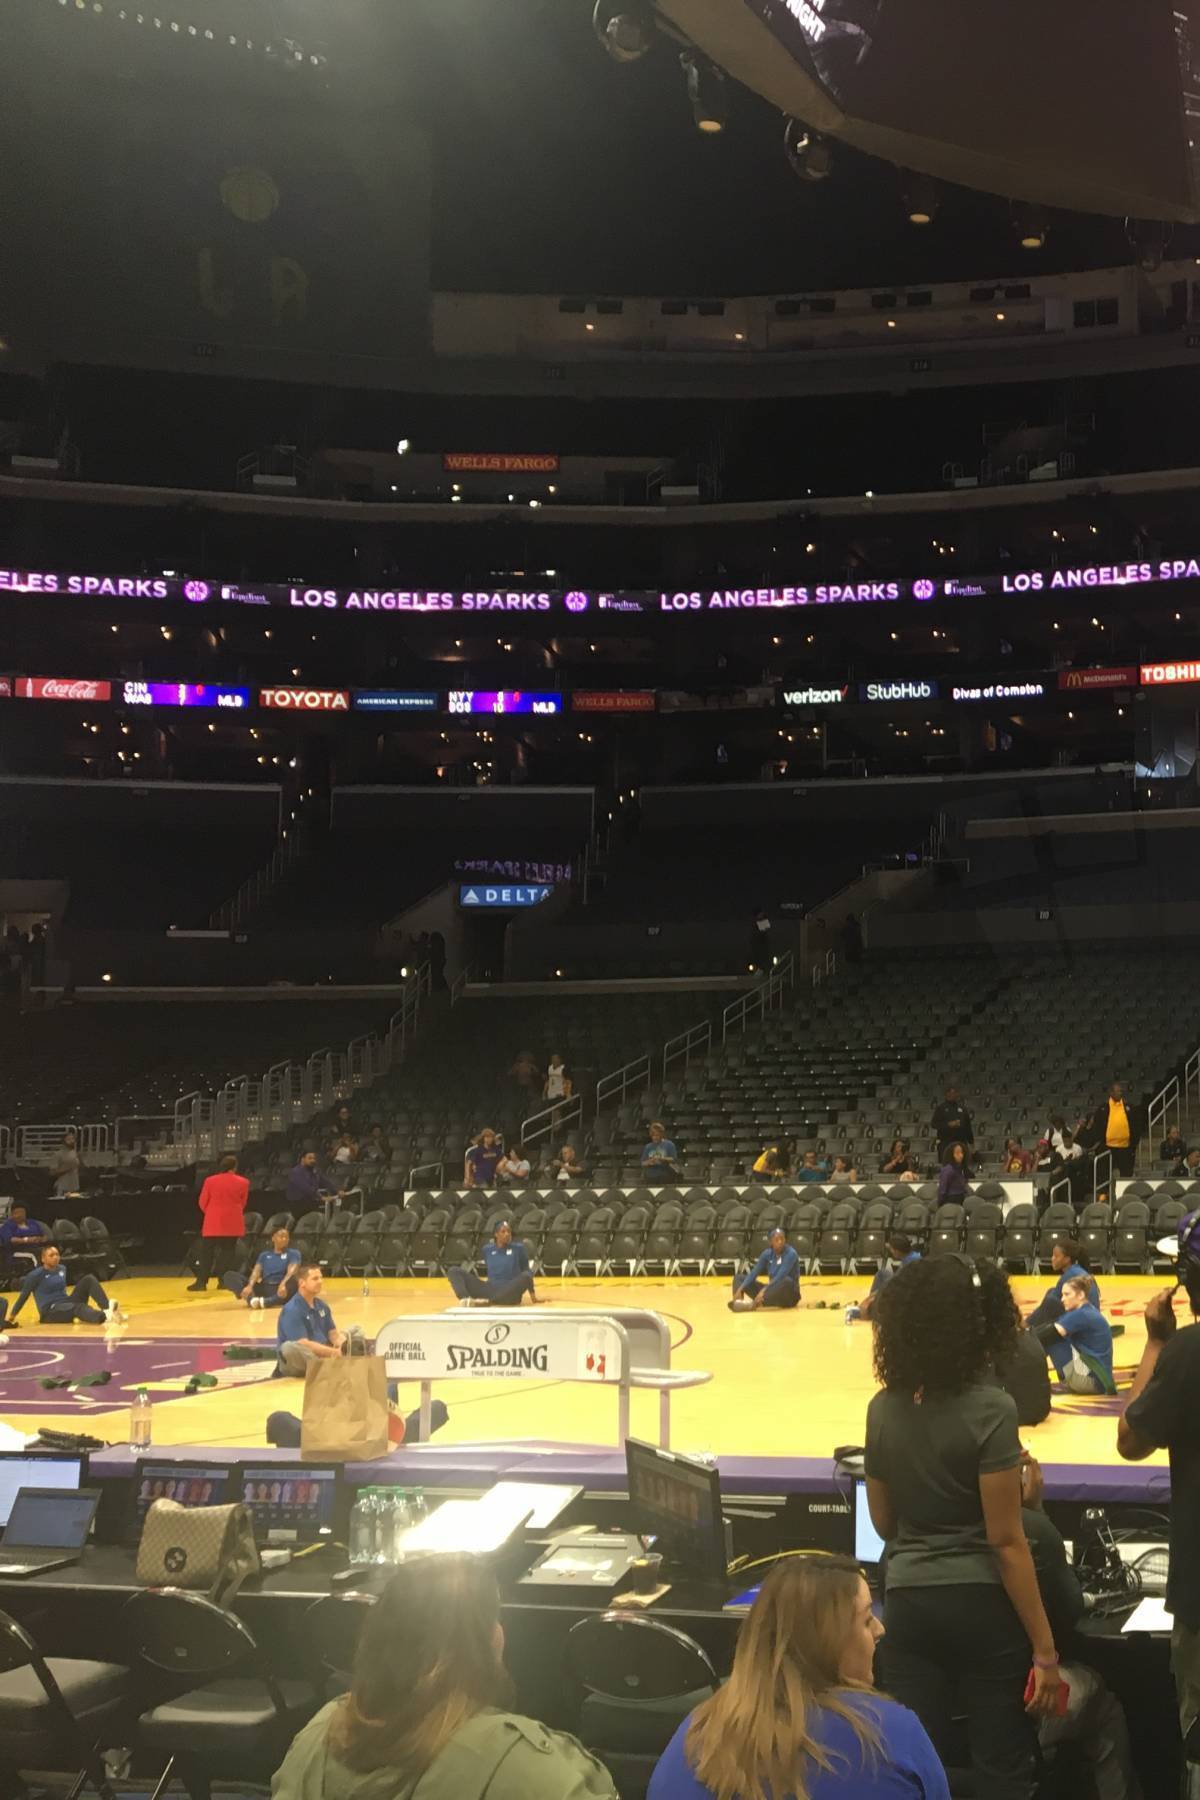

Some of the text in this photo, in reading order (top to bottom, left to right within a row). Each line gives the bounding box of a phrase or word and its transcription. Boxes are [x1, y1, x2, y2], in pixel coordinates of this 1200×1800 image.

[447, 457, 557, 470] WELLS FARGO
[1002, 572, 1043, 593] LOS
[1050, 563, 1151, 588] ANGELES
[68, 576, 168, 598] SPARKS
[290, 588, 550, 611] LOS ANGELES SPARKS
[661, 583, 898, 611] LOS ANGELES SPARKS
[124, 682, 148, 694] CIN
[866, 682, 931, 701] StubHub
[953, 686, 982, 700] Divas
[983, 685, 994, 698] of
[261, 690, 348, 709] TOYOTA
[399, 698, 434, 706] EXPRESS
[448, 691, 474, 702] NYY
[576, 696, 655, 706] WELLS FARGO
[783, 687, 842, 705] verizon
[448, 702, 472, 713] BOS
[389, 1342, 422, 1351] OFFICIAL
[384, 1352, 426, 1361] GAME BALL
[446, 1343, 548, 1372] SPALDING
